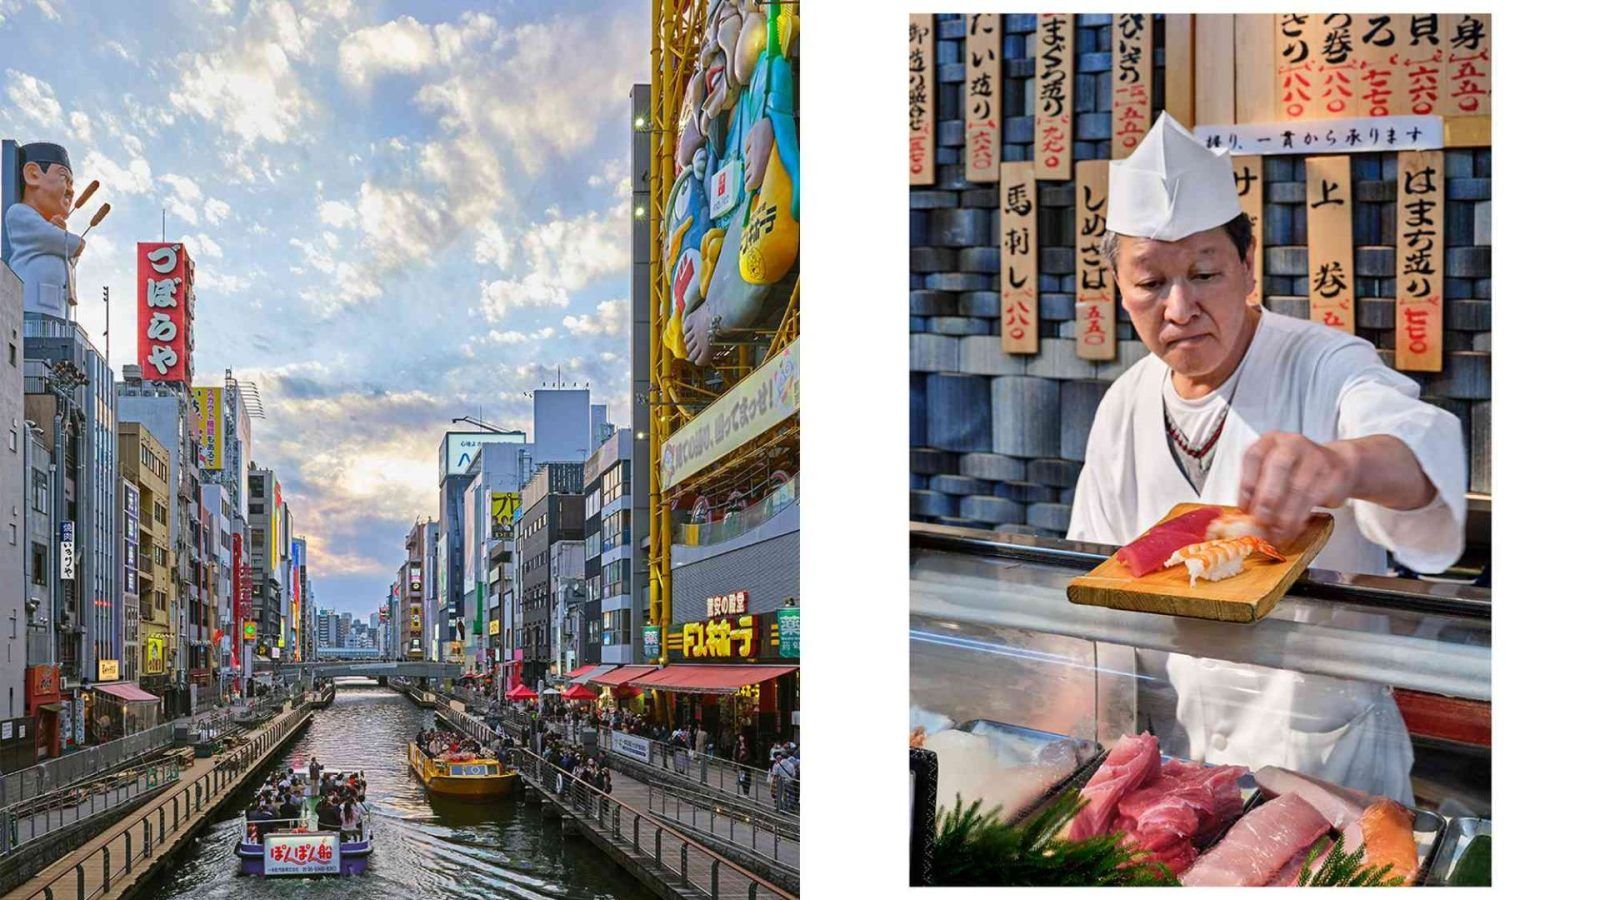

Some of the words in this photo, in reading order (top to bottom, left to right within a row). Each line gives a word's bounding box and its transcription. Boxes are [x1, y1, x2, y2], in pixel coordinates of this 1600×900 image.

[1004, 183, 1032, 289] 馬刺し
[147, 245, 182, 376] づぼらや
[270, 843, 333, 865] ぽんぽん船
